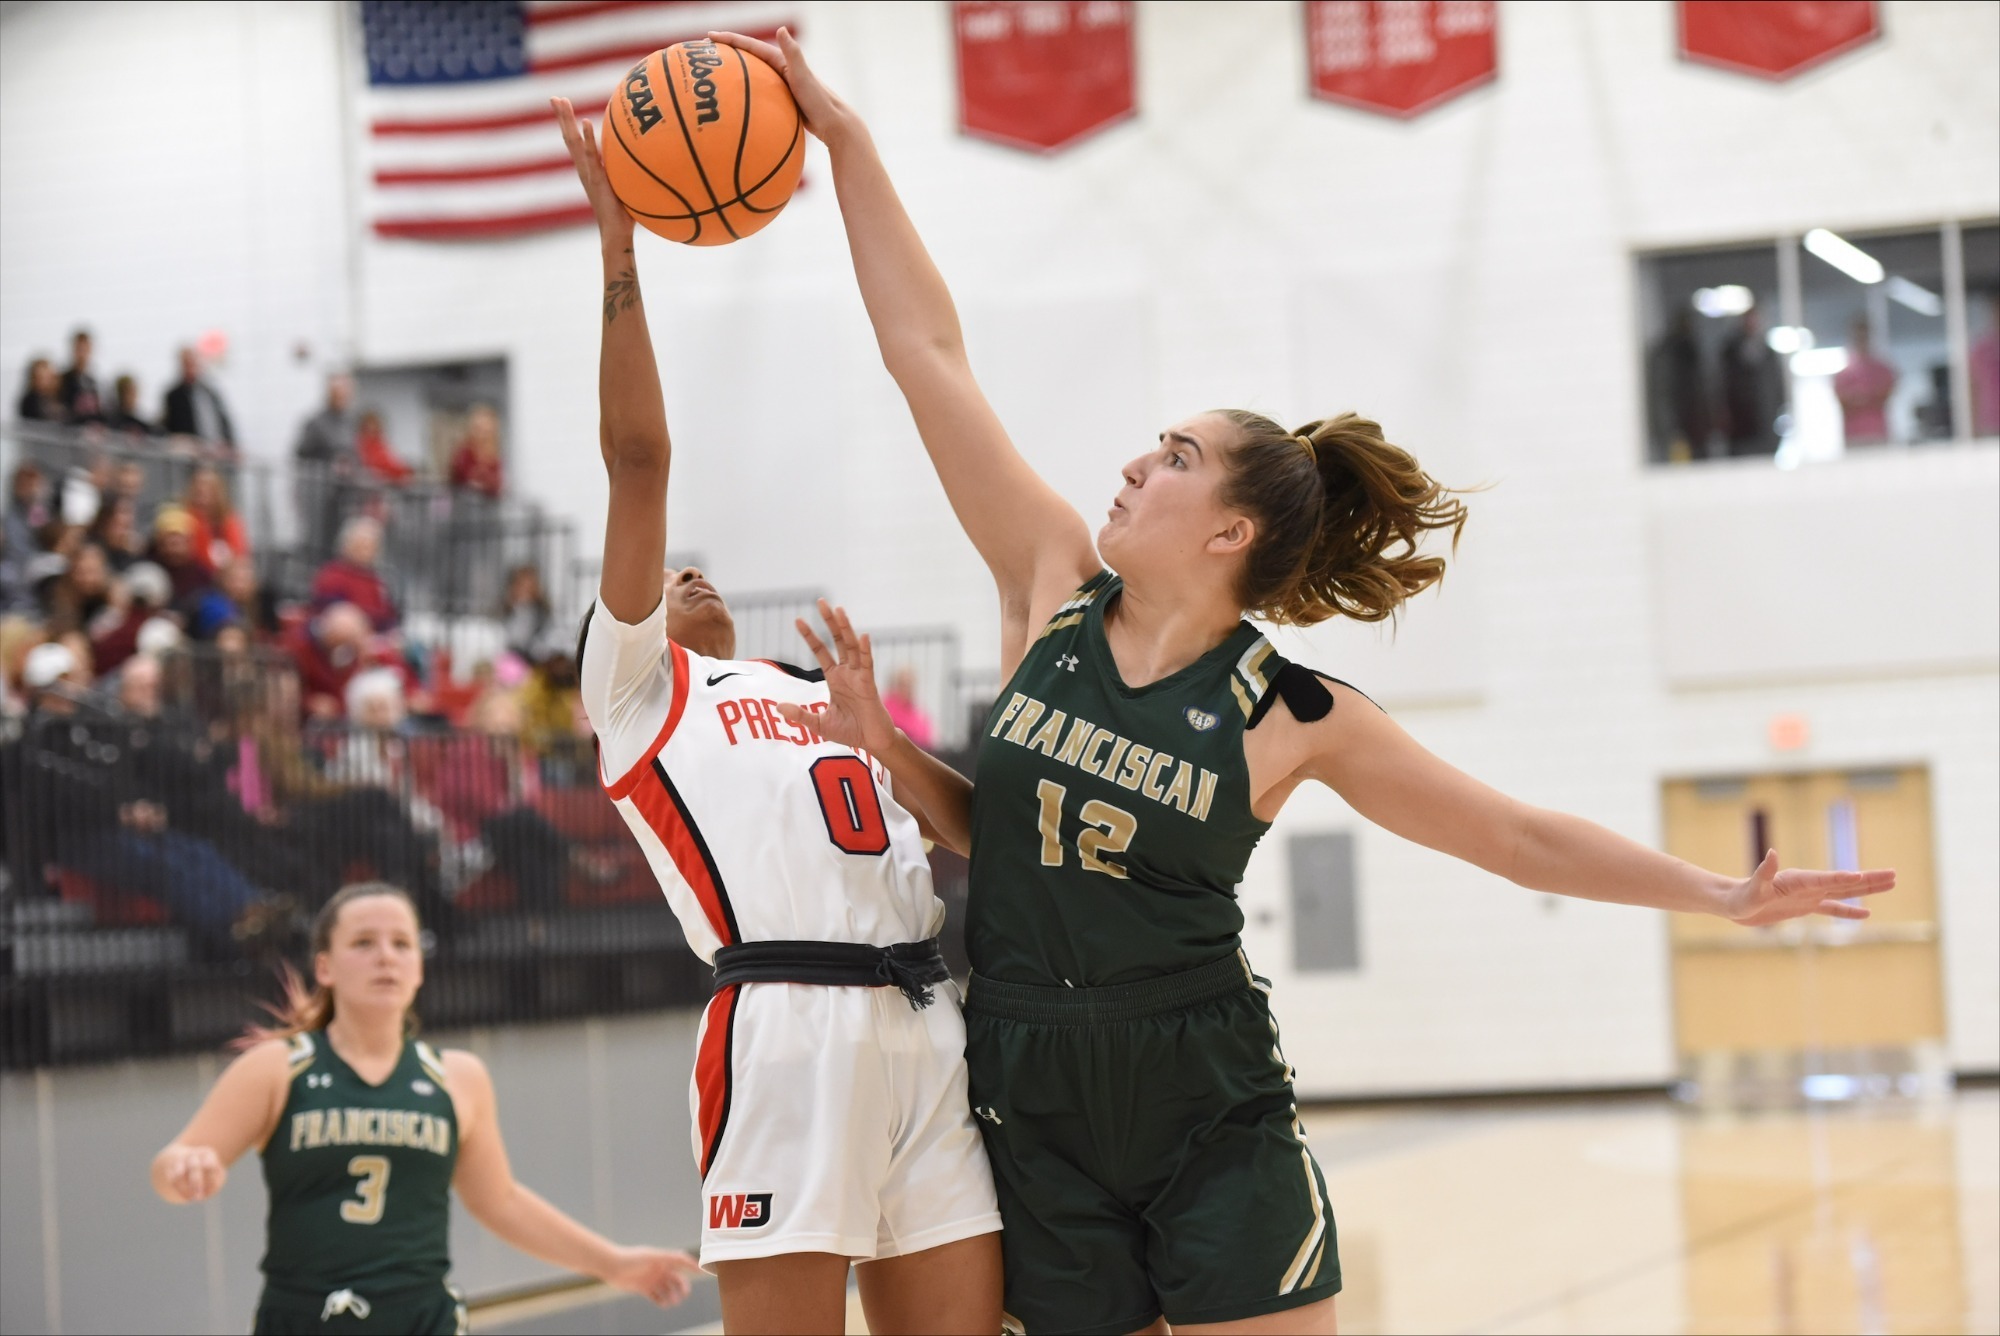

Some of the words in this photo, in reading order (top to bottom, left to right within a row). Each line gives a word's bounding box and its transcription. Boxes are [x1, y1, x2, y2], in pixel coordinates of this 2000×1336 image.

[1189, 711, 1212, 727] PAC
[990, 692, 1219, 822] FRANCISCAN
[809, 756, 890, 856] 0
[1036, 778, 1138, 880] 12
[289, 1107, 451, 1157] FRANCISCAN
[339, 1154, 392, 1226] 3
[709, 1193, 773, 1229] W&J
